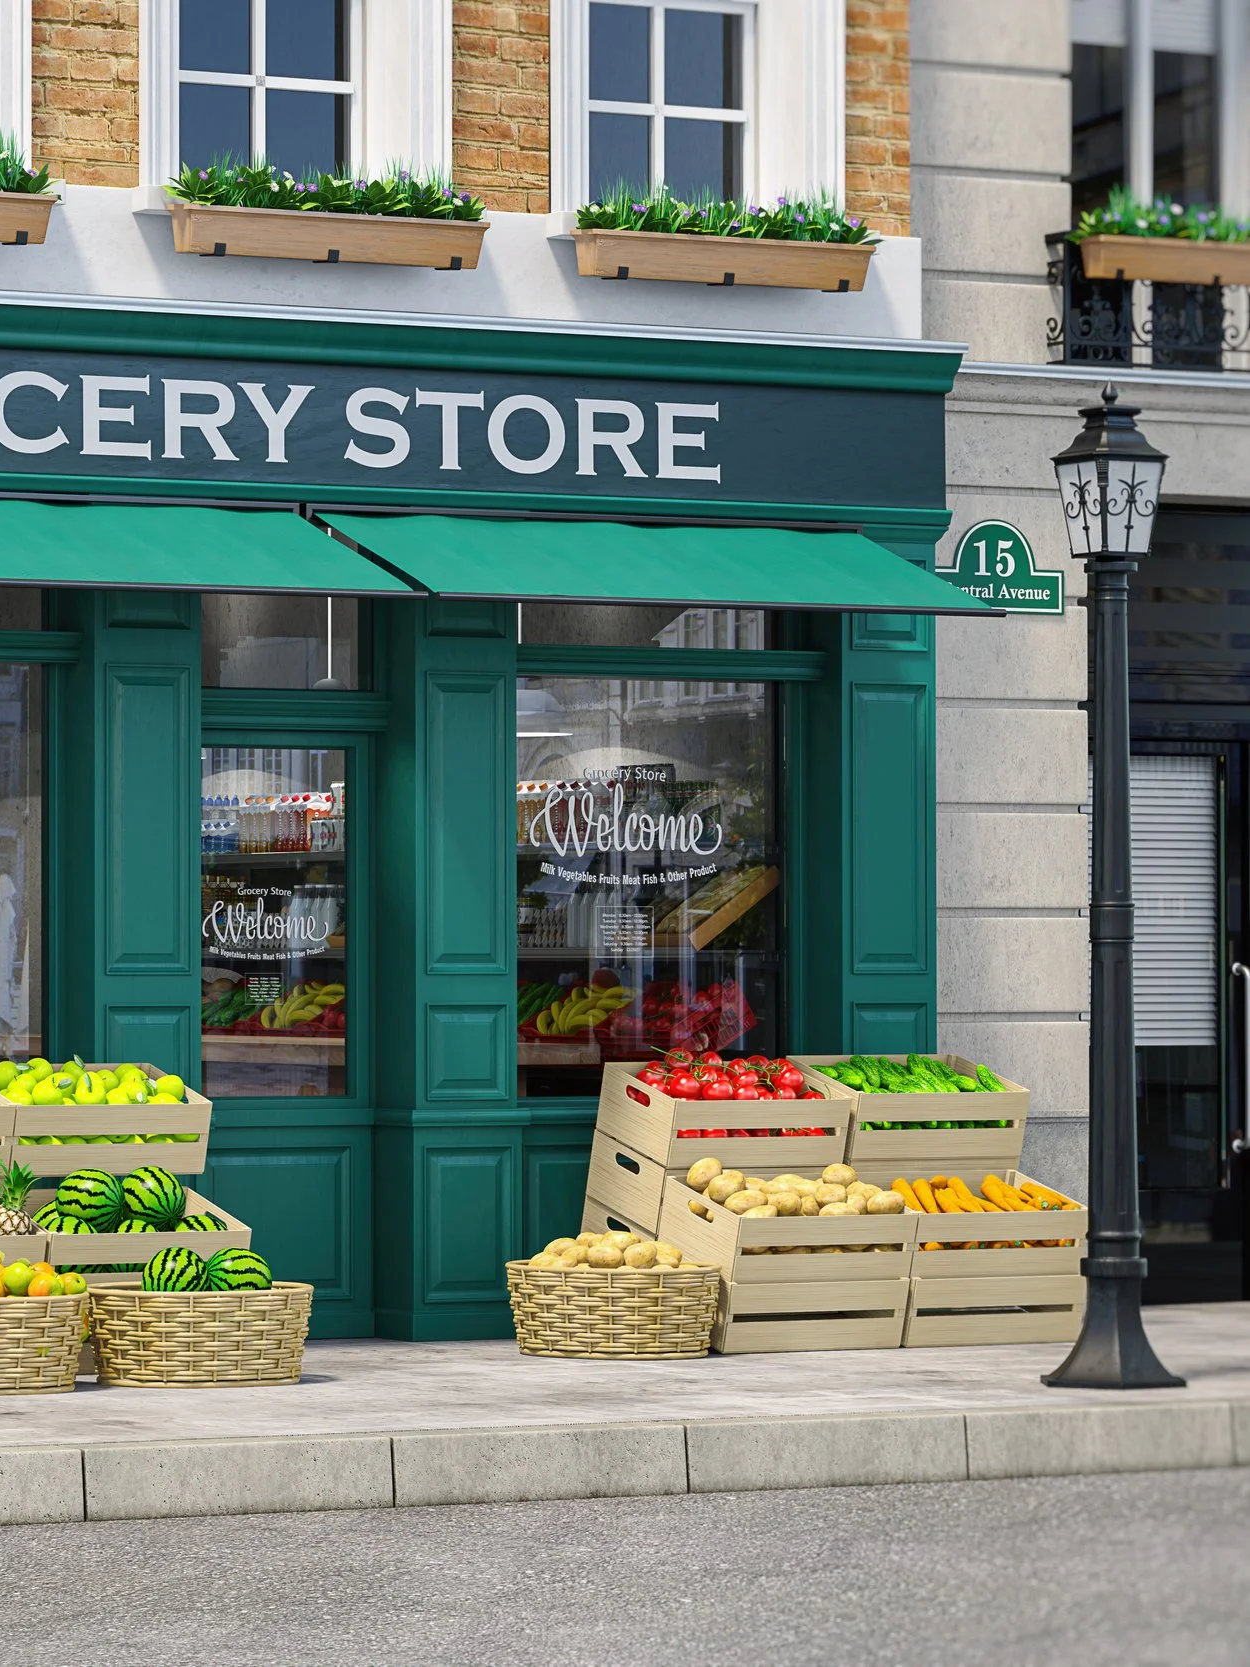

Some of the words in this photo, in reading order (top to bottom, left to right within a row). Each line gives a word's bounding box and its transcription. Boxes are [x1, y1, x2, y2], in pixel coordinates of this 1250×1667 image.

[345, 386, 721, 484] STORE
[973, 540, 1015, 577] 15
[949, 582, 994, 598] ntral
[997, 583, 1050, 600] Avenue
[583, 767, 631, 781] Grocery
[634, 766, 667, 782] Store
[530, 783, 722, 857] Welcome
[540, 862, 555, 875] Milk
[557, 866, 597, 883] Vegetables
[599, 873, 620, 885] Fruits
[623, 874, 640, 885] Meat
[643, 873, 658, 884] Fish
[660, 872, 666, 883] &
[667, 869, 687, 882] Other
[689, 862, 717, 879] Product
[237, 887, 269, 896] Grocery
[271, 887, 292, 896] Store
[202, 897, 328, 943] Welcome
[220, 949, 246, 959] Vegetables
[247, 952, 261, 960] Fruits
[292, 950, 306, 958] Other
[306, 946, 325, 956] Product
